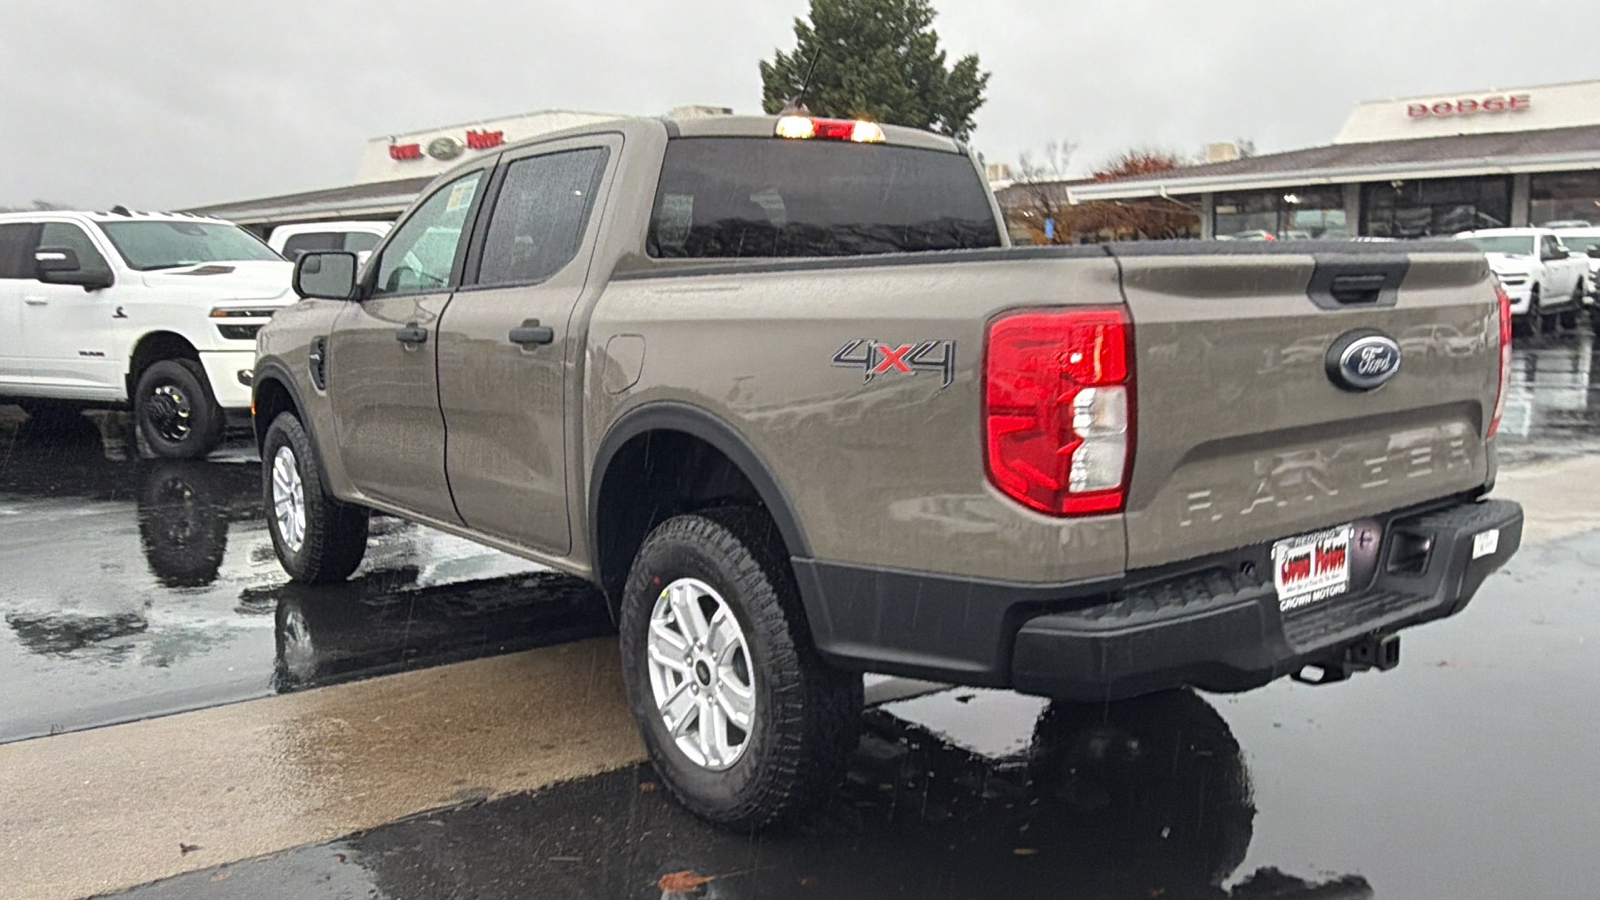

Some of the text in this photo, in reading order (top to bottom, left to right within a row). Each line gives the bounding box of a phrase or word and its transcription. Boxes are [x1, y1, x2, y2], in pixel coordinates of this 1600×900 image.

[1408, 94, 1530, 118] DODGE
[1358, 346, 1392, 375] Ford
[1180, 438, 1474, 527] RANGER
[1280, 593, 1312, 611] CROWN
[1312, 582, 1346, 602] MOTORS
